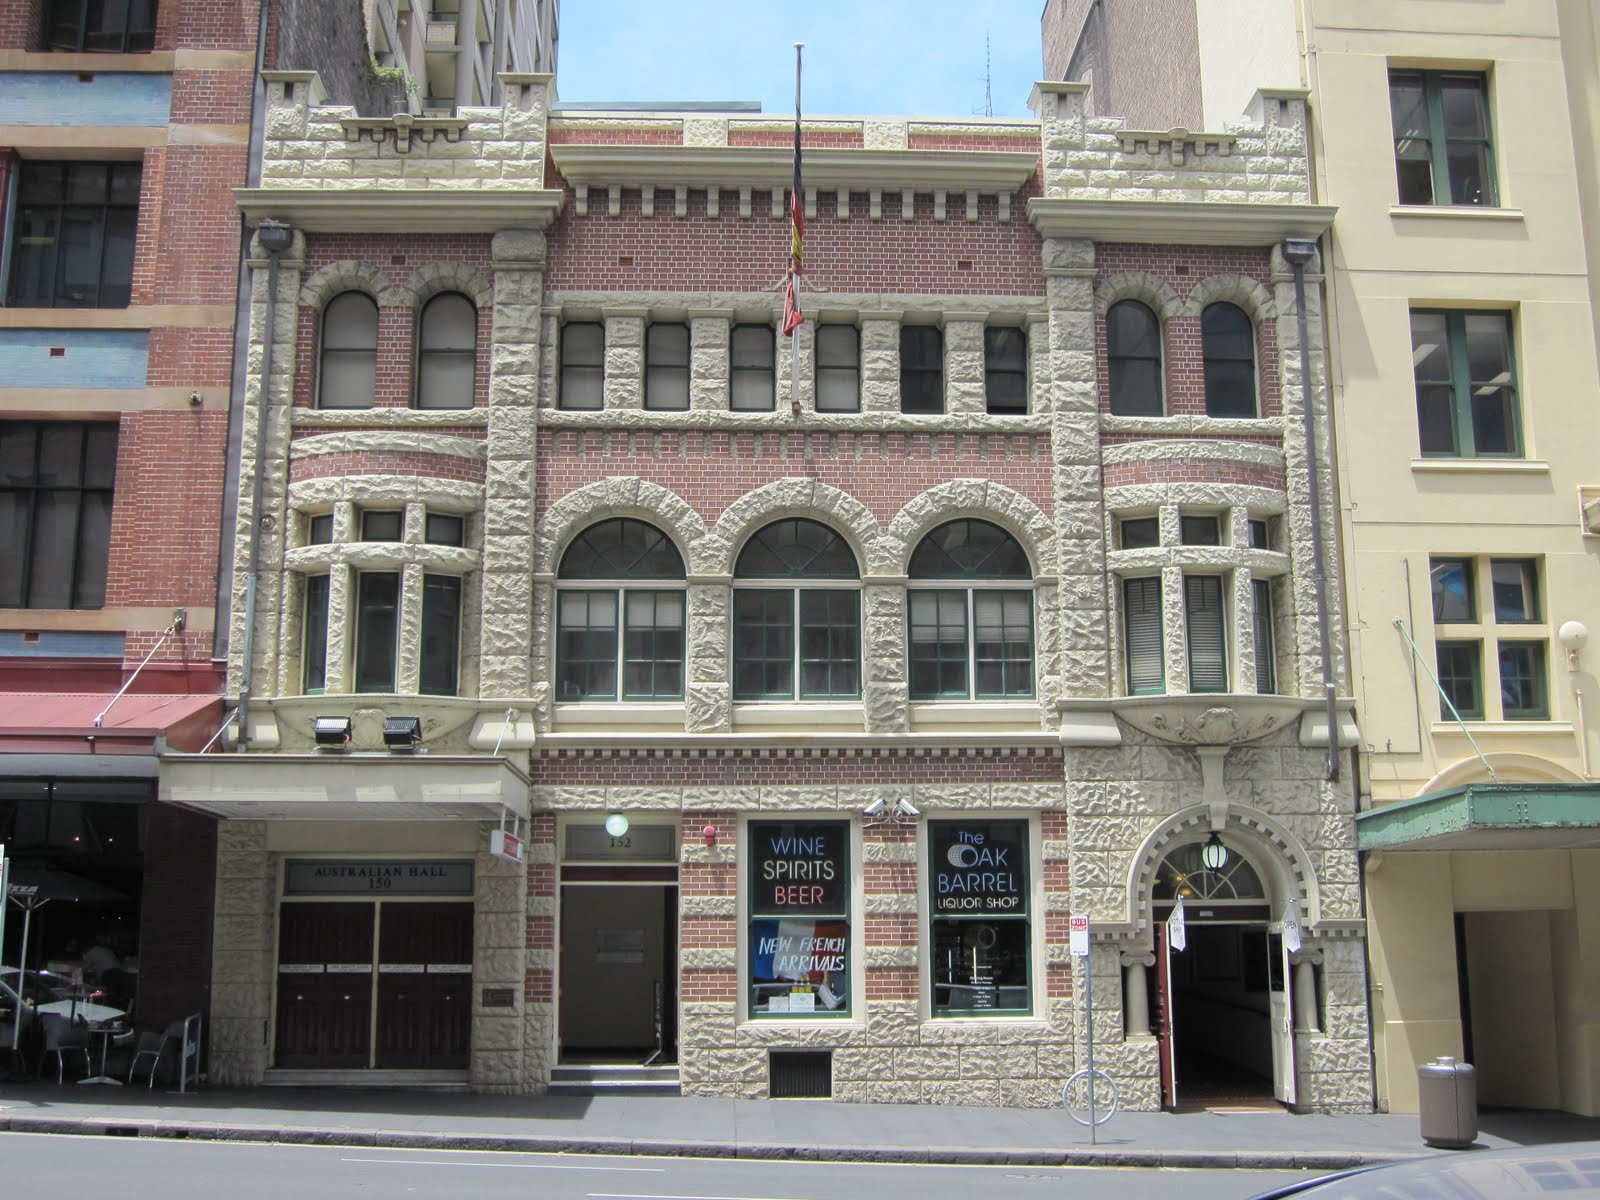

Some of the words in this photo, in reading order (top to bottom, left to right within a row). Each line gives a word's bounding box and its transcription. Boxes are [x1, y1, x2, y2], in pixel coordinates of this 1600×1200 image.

[609, 837, 631, 848] 152
[771, 837, 824, 855] WINE
[958, 831, 985, 844] The
[951, 845, 1008, 867] OAK
[314, 866, 402, 877] AUSTRALIAN
[409, 867, 448, 877] HALL
[763, 860, 834, 880] SPIRITS
[368, 878, 392, 889] 150
[938, 873, 1018, 893] BARREL
[775, 886, 824, 905] BEER
[938, 897, 982, 909] LIQUOR
[986, 897, 1019, 908] SHOP
[759, 937, 793, 955] NEW
[800, 937, 845, 953] FRENCH
[779, 955, 845, 971] ARRIVALS
